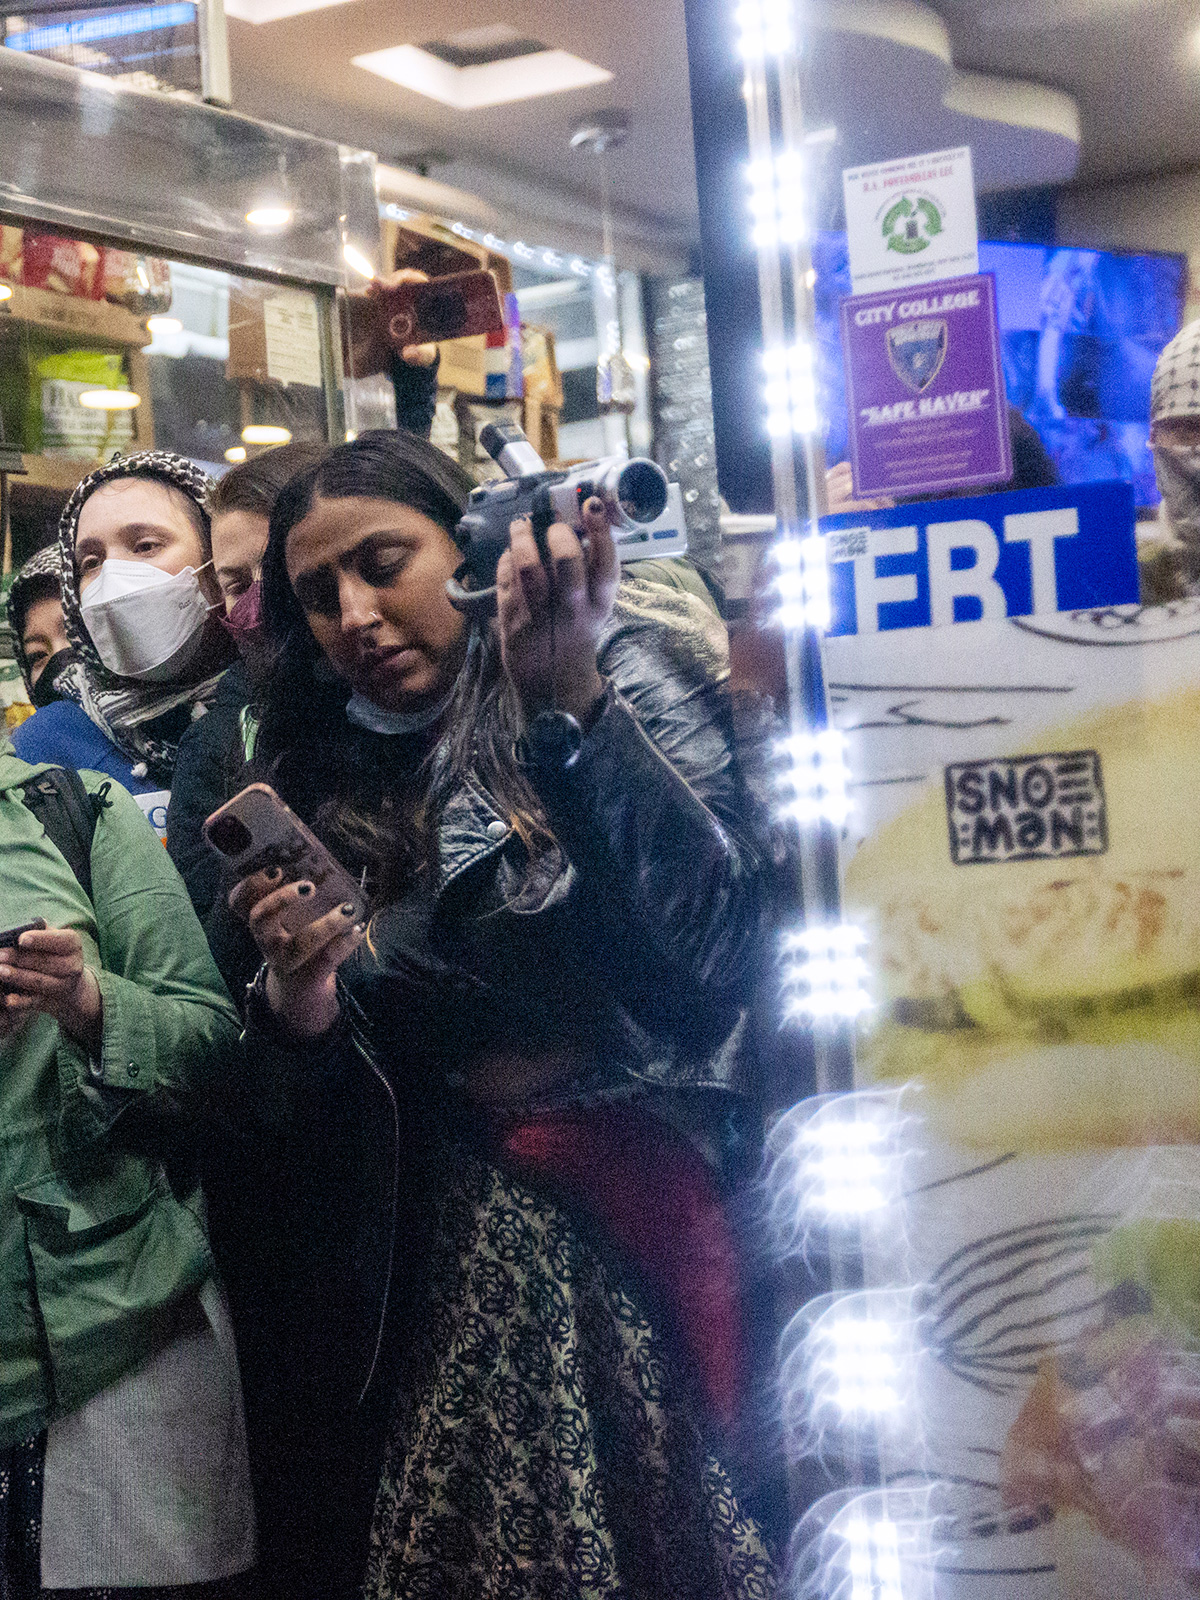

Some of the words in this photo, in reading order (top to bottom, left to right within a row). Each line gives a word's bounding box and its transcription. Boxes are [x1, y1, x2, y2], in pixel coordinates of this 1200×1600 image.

[855, 302, 897, 328] CITY
[899, 291, 980, 318] COLLEGE
[853, 506, 1080, 634] EBT
